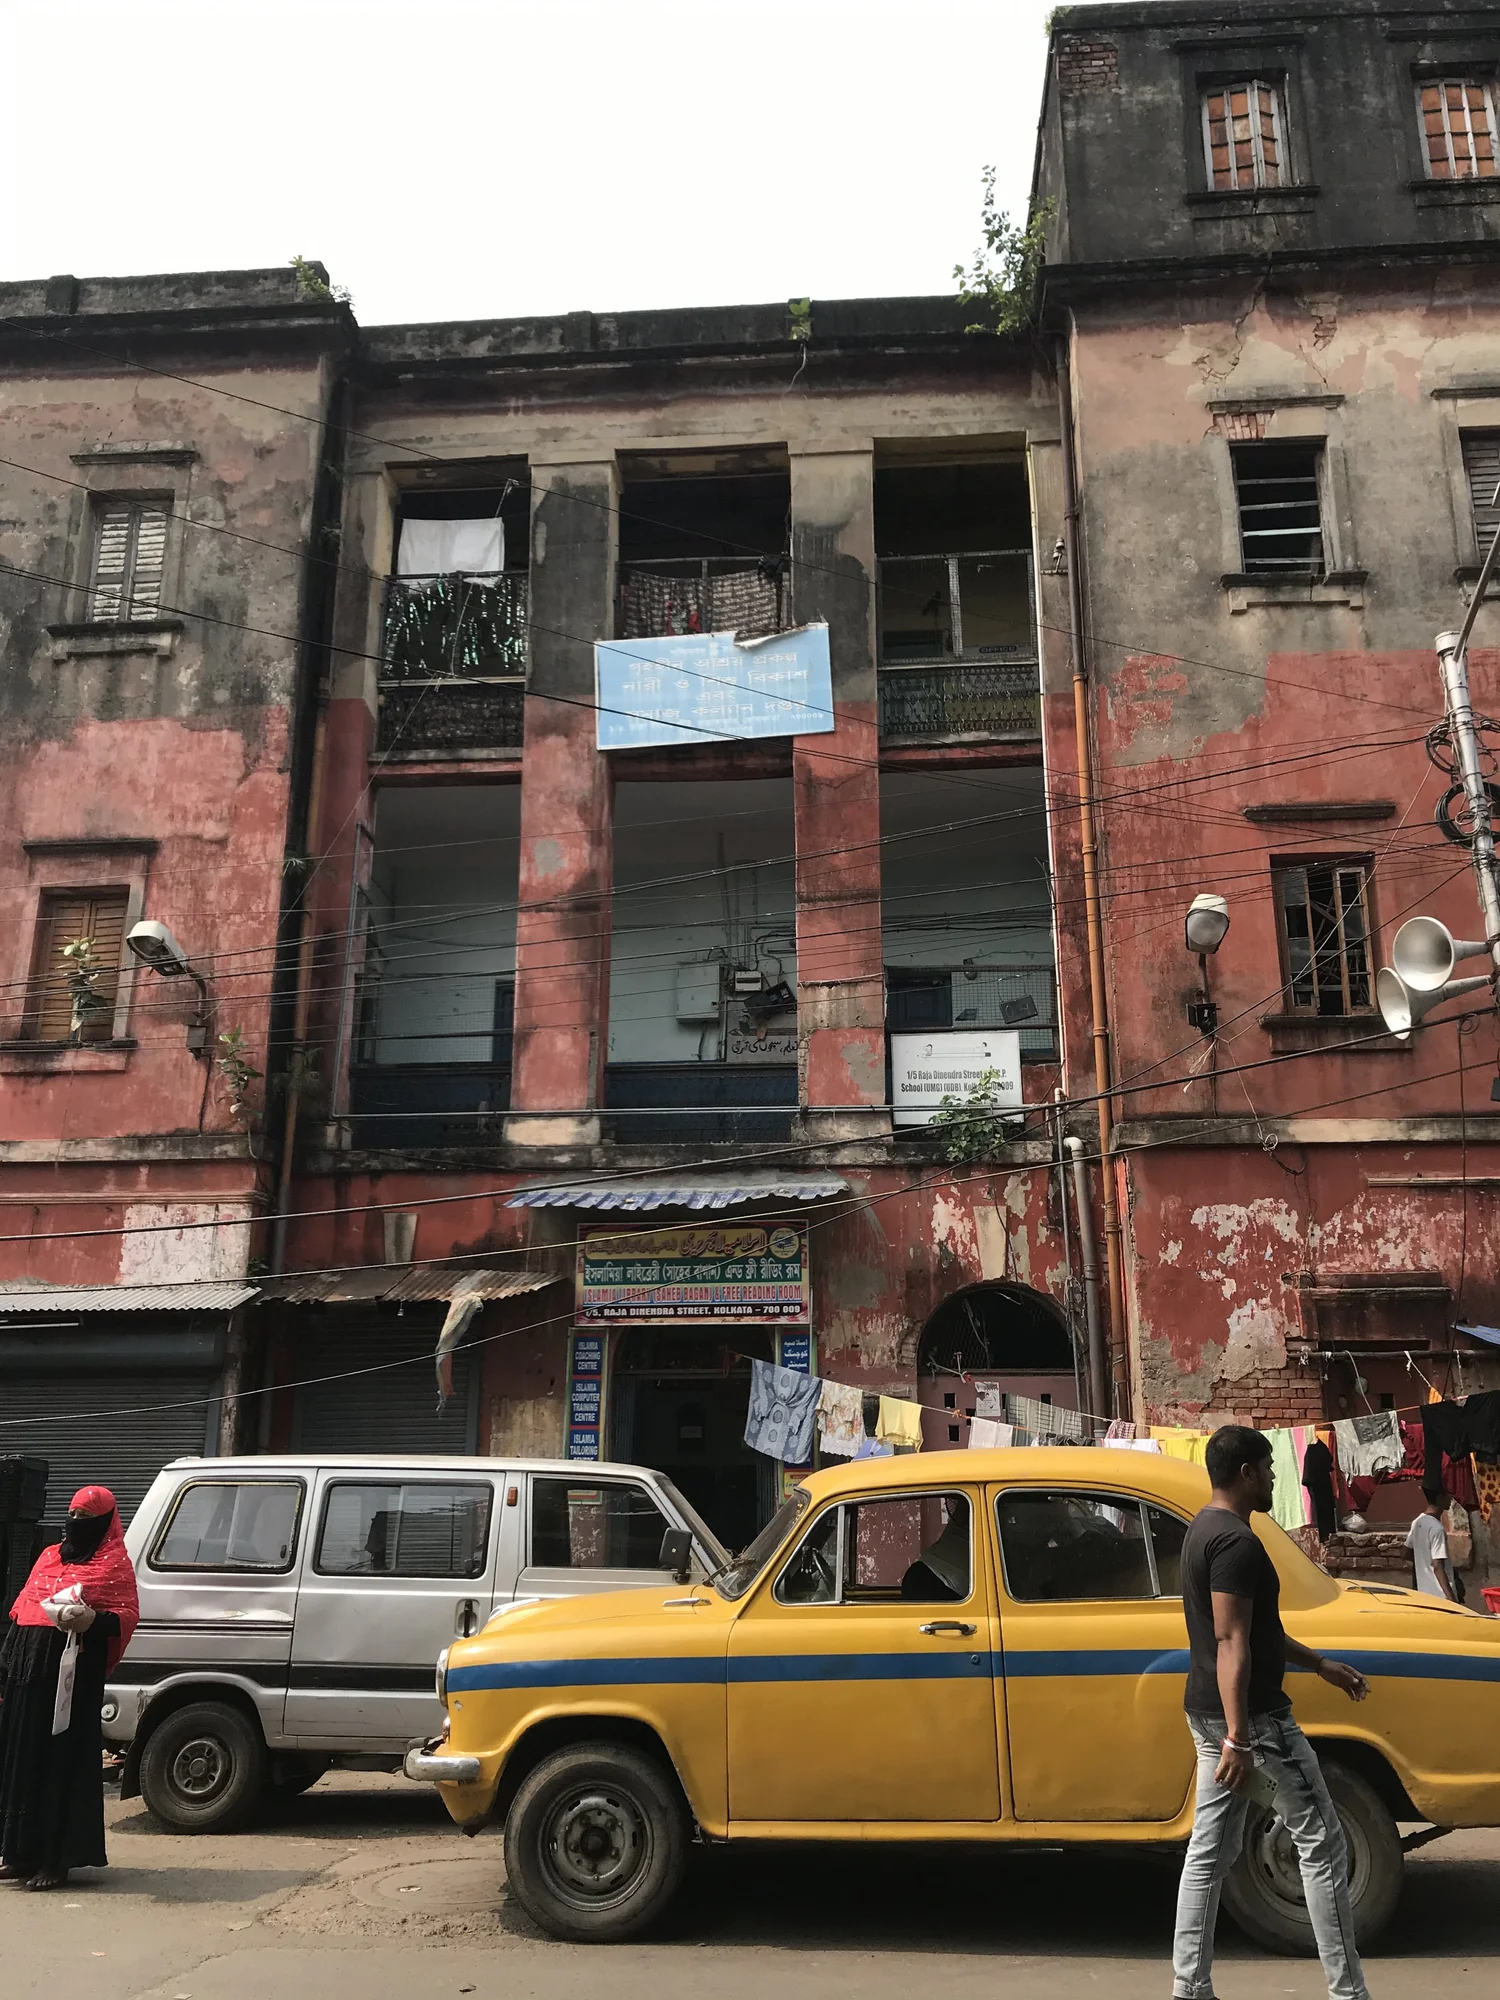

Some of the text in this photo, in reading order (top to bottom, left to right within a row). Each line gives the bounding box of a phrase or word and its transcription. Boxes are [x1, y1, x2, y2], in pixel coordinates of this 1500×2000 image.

[622, 678, 661, 691] নারী
[672, 679, 690, 689] ও
[747, 669, 809, 683] বিকাশ
[696, 691, 736, 702] এবং
[906, 1070, 918, 1080] 1/5
[918, 1070, 932, 1081] Raja
[933, 1069, 963, 1080] Dinendra
[963, 1069, 984, 1079] Street
[901, 1082, 924, 1092] School
[584, 1261, 624, 1283] ইসলামিয়া
[626, 1260, 661, 1283] লাইব্রেরী
[744, 1258, 759, 1280] ফ্রী
[759, 1257, 784, 1280] রীডিং
[584, 1285, 802, 1304] ISLAMIA LIBRARY (SAHEB BAGAN) & FREE READING ROOM
[603, 1308, 628, 1316] RAJA
[629, 1307, 675, 1316] DINENDRA
[713, 1305, 753, 1315] KOLKATA
[763, 1305, 780, 1314] 700
[782, 1305, 801, 1314] 009
[577, 1341, 599, 1350] ISLAMIA
[574, 1351, 601, 1360] COACHING
[577, 1361, 598, 1370] CENTRE
[575, 1382, 597, 1392] ISLAMIA
[571, 1393, 601, 1402] COMPUTER
[573, 1402, 598, 1412] TRAINING
[574, 1412, 596, 1422] CENTRE
[573, 1434, 596, 1444] ISLAMIA
[569, 1445, 598, 1455] TAILORING
